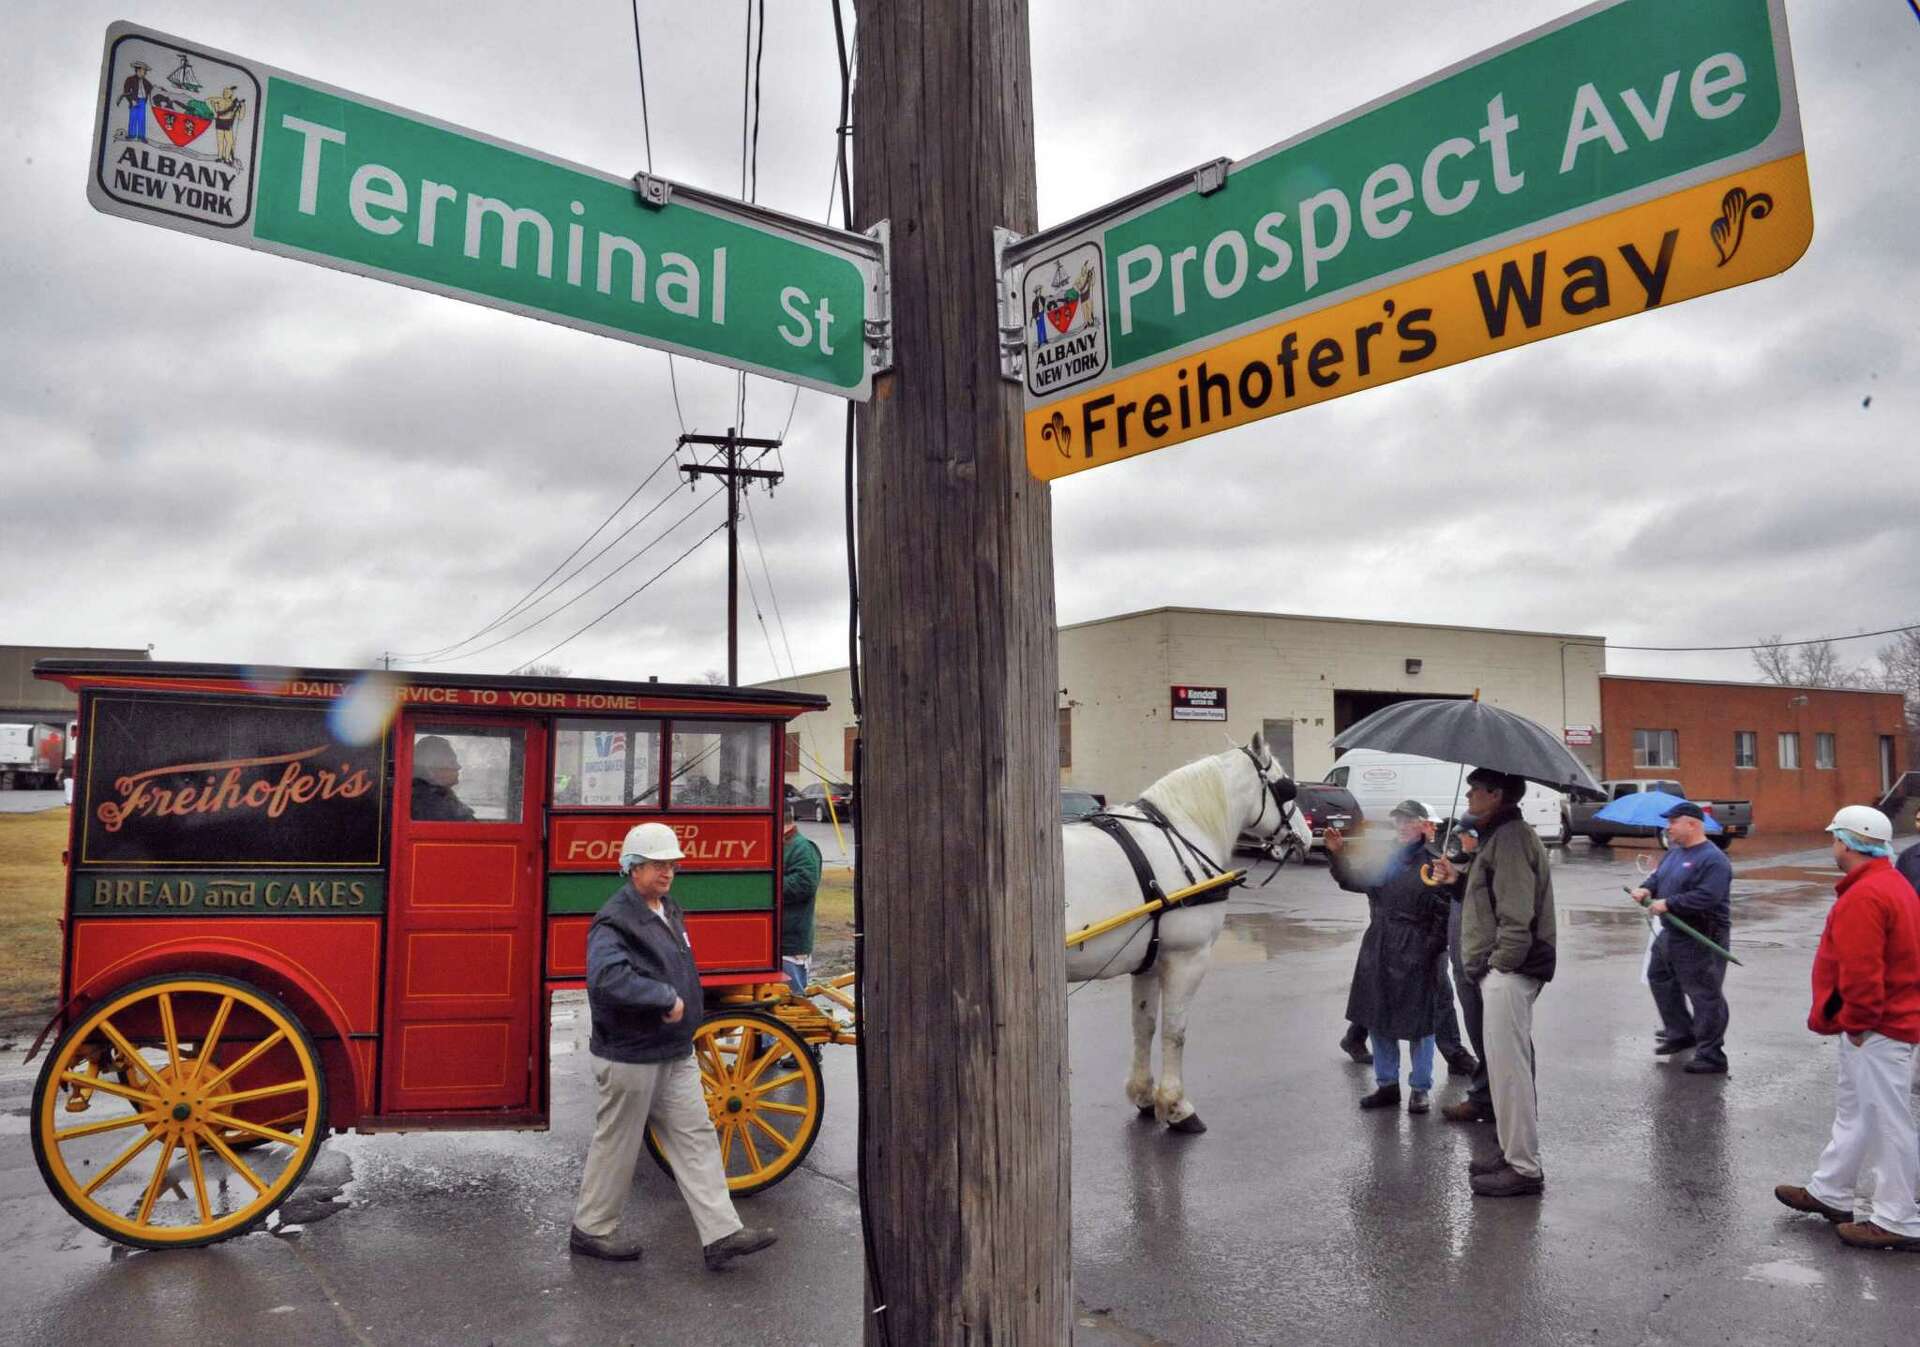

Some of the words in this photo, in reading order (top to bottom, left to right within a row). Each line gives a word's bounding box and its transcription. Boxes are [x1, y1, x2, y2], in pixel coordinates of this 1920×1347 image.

[117, 147, 236, 192] ALBANY
[114, 169, 168, 199] NEW
[172, 183, 233, 216] YORK
[1117, 92, 1525, 336] Prospect
[1559, 52, 1748, 175] Ave
[282, 114, 727, 325] Terminal
[777, 286, 834, 356] St
[1036, 331, 1097, 369] ALBANY
[1082, 299, 1437, 459] Freihofer's
[1473, 228, 1680, 339] Way
[1036, 365, 1062, 388] NEW
[1065, 352, 1099, 377] YORK
[292, 682, 350, 697] DAILY
[372, 684, 459, 703] ERVICE
[469, 690, 498, 704] TO
[510, 691, 565, 707] YOUR
[576, 694, 637, 710] HOME
[97, 743, 373, 833] Freihofer's
[567, 840, 623, 860] FOR
[683, 840, 757, 858] ALITY
[93, 879, 195, 906] BREAD
[204, 880, 256, 906] and
[265, 880, 365, 907] CAKES
